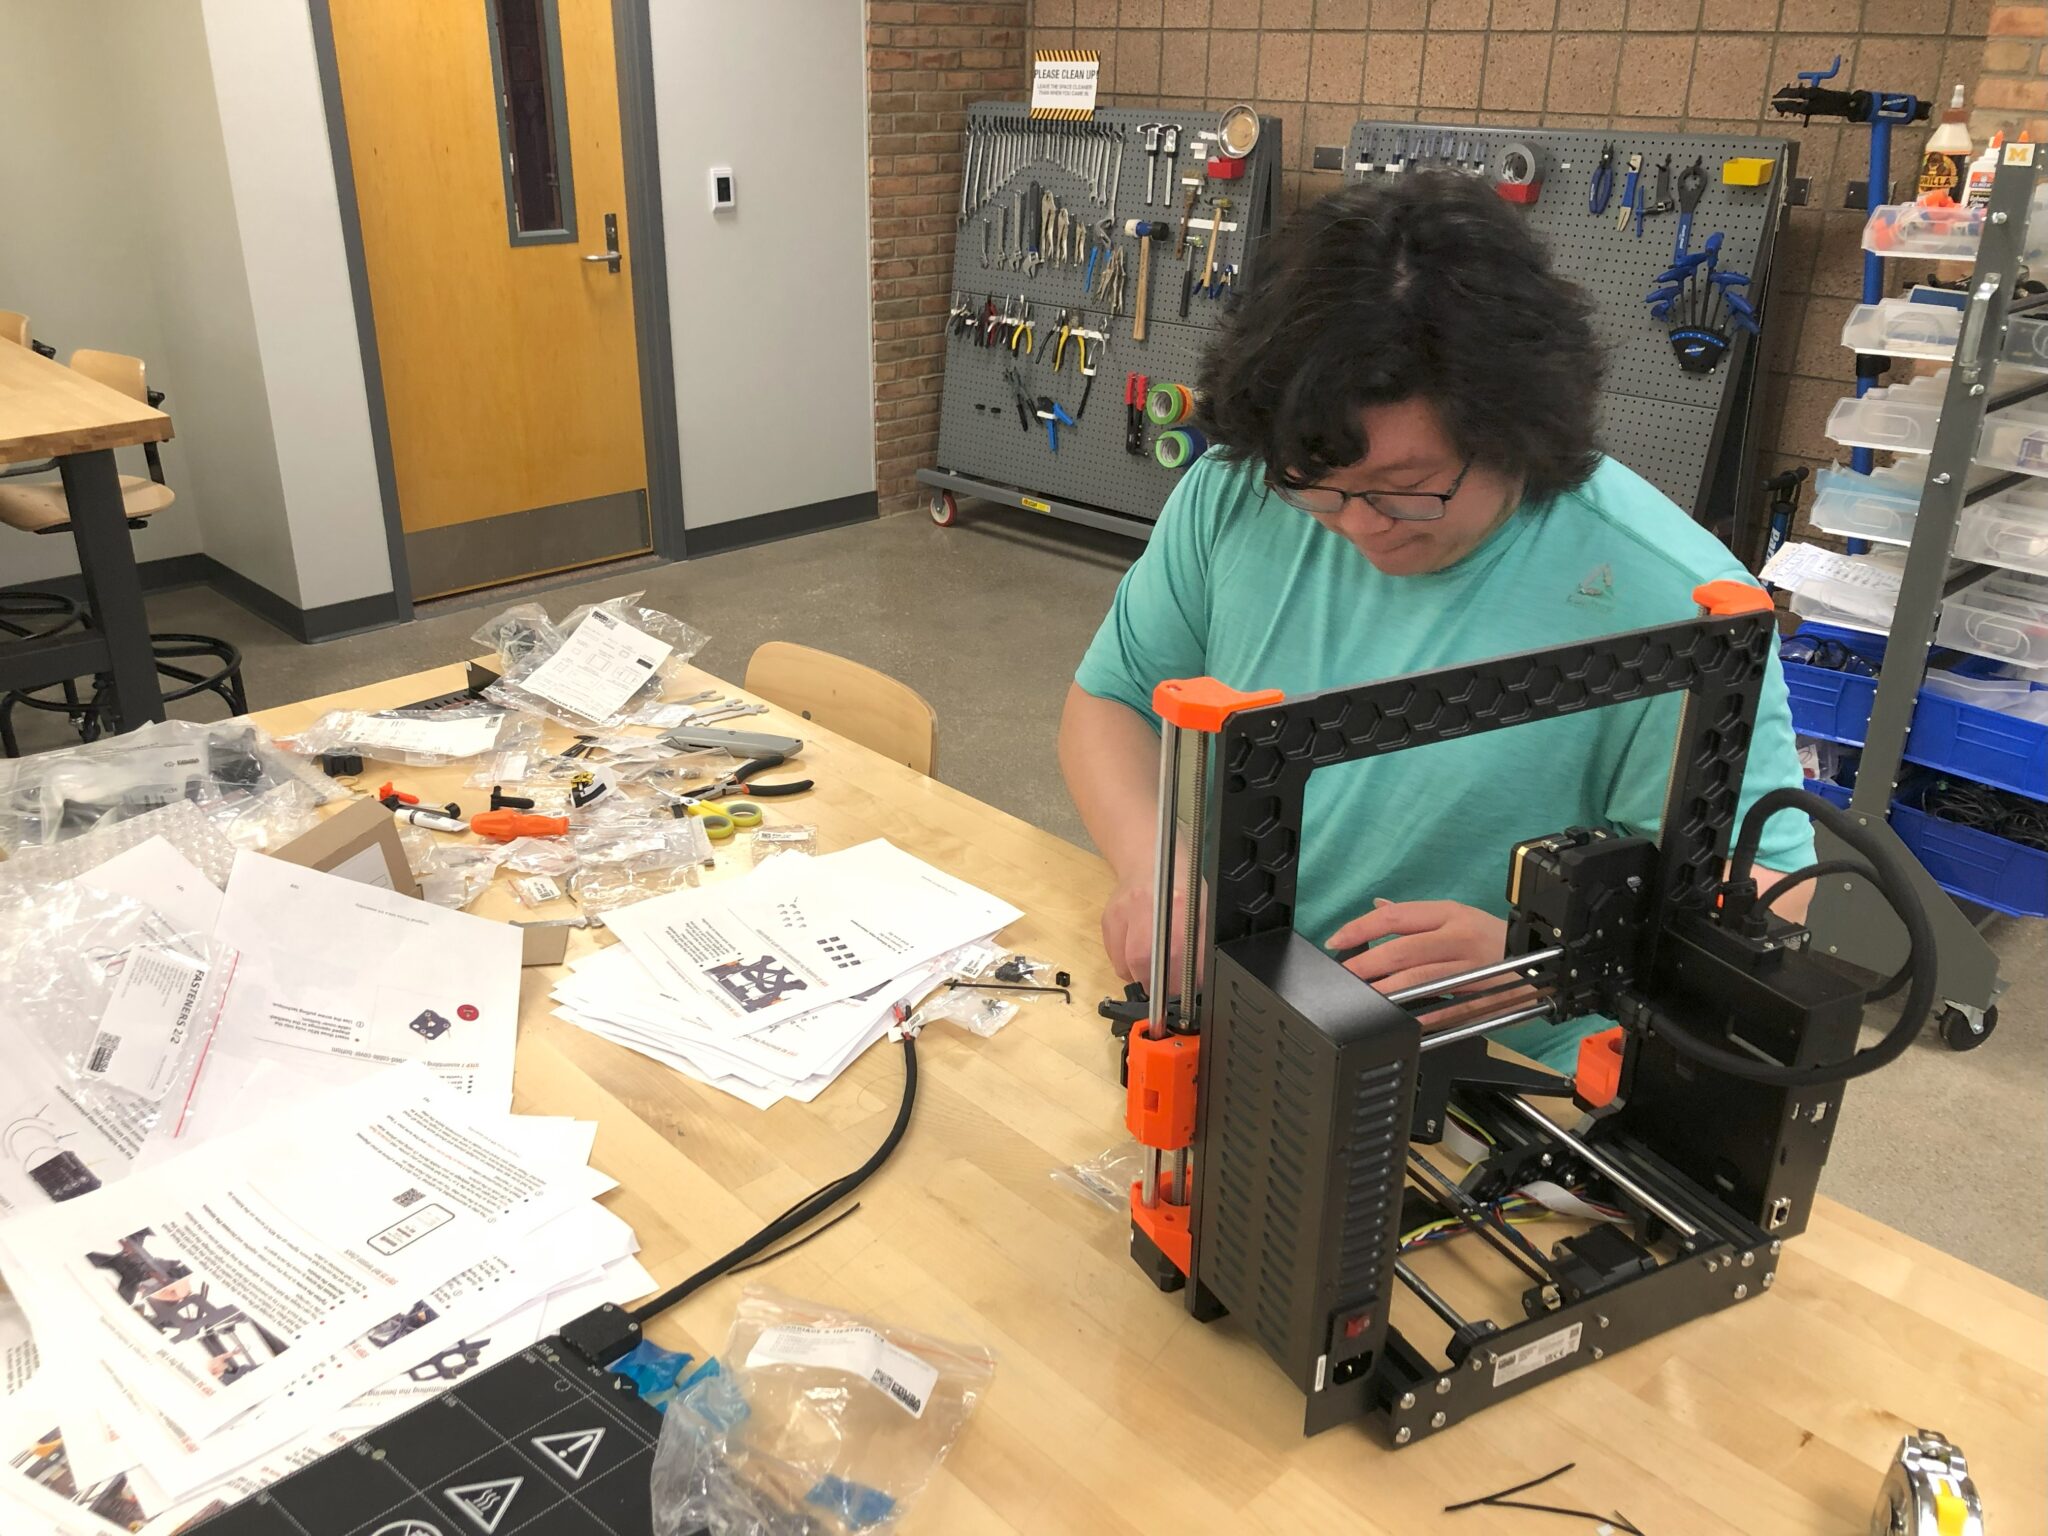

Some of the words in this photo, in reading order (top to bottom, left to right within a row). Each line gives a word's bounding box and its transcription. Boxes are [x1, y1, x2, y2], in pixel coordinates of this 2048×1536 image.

[1034, 69, 1060, 79] PLEASE
[1061, 69, 1084, 80] CLEAN
[1085, 69, 1100, 80] UP!
[2006, 147, 2030, 162] M
[176, 968, 206, 1031] FASTENERS
